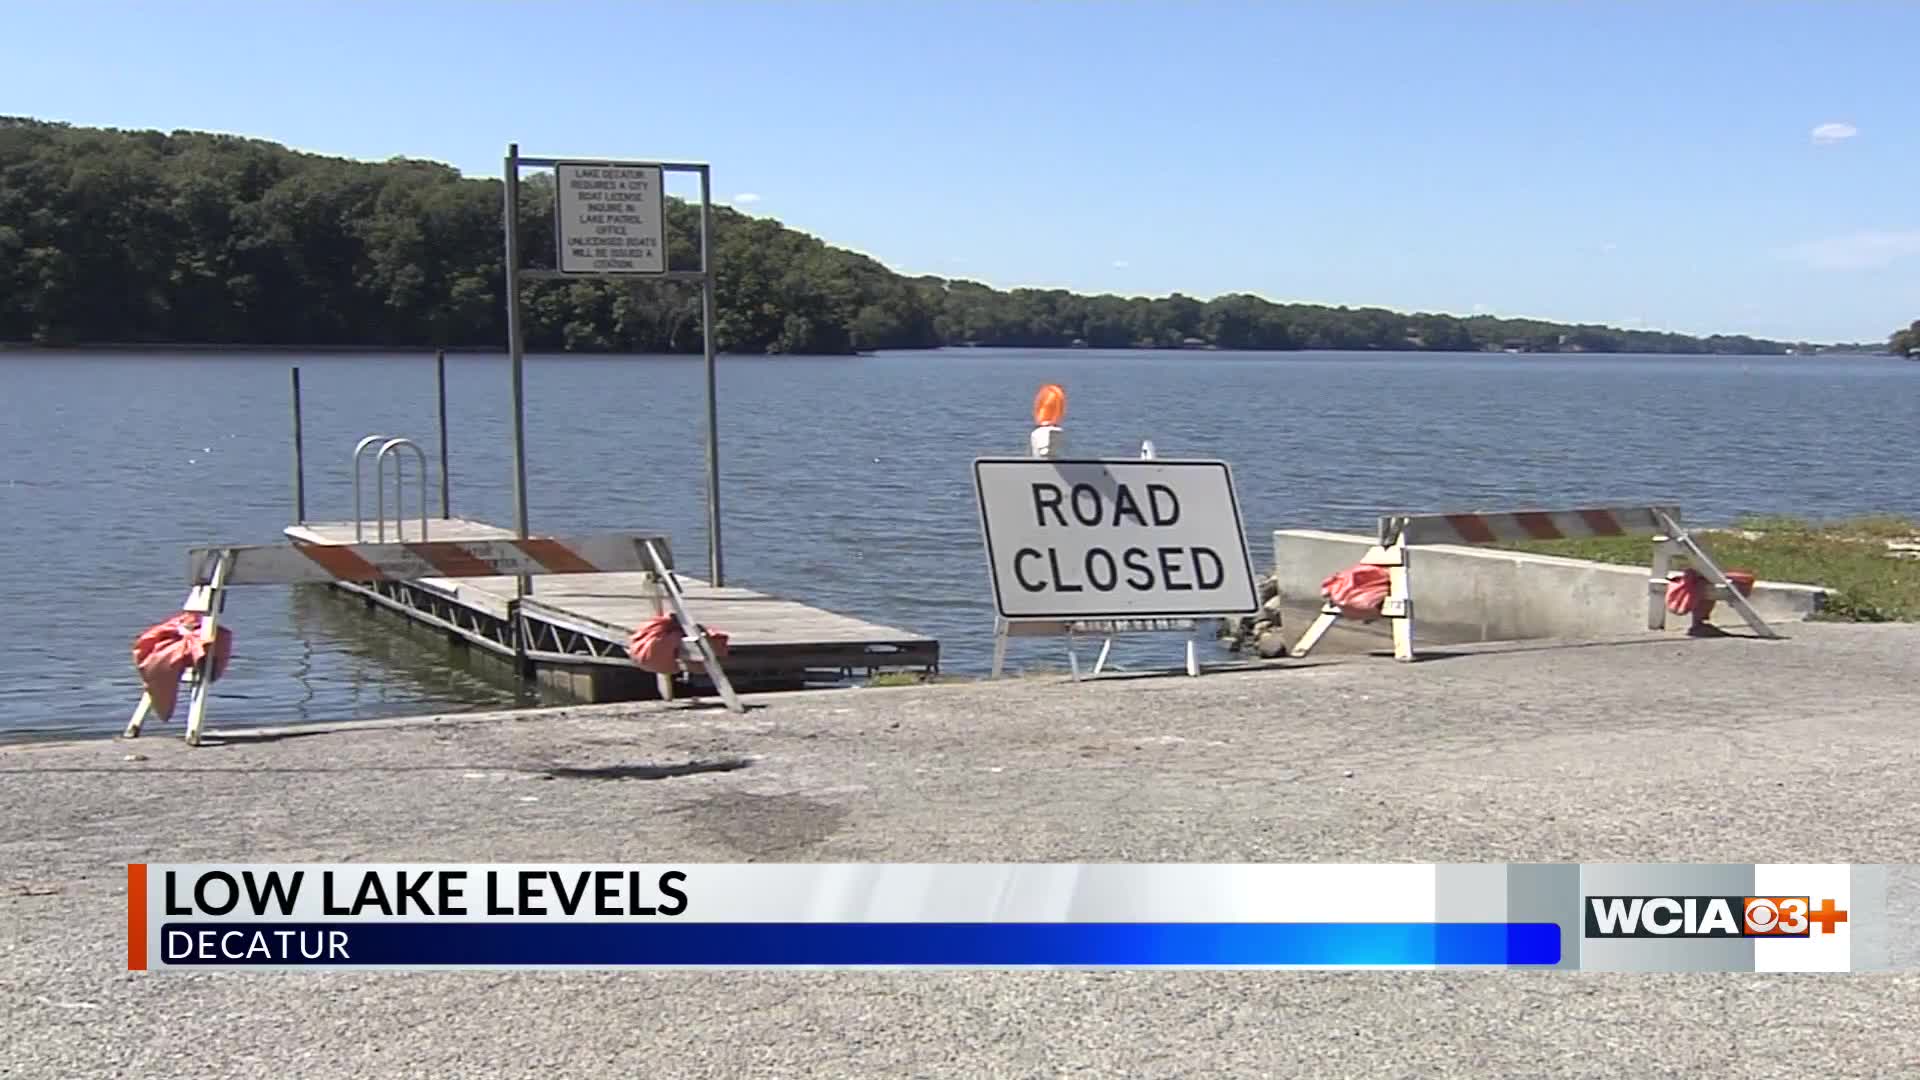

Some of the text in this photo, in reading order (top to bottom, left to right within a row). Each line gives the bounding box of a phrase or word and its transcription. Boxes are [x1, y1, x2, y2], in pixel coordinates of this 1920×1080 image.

[576, 169, 645, 179] LAKE DECATUR
[570, 180, 649, 190] REQUIRES A CITY
[578, 192, 643, 202] BOAT LICENSE
[587, 203, 636, 213] INQUIRE IN
[579, 215, 643, 224] LAKE PATROL
[595, 225, 628, 235] OFFICE
[568, 237, 657, 247] UNLICENSED BOATS
[572, 248, 653, 257] WILL BE ISSUED A
[1031, 483, 1180, 528] ROAD
[1013, 547, 1225, 593] CLOSED
